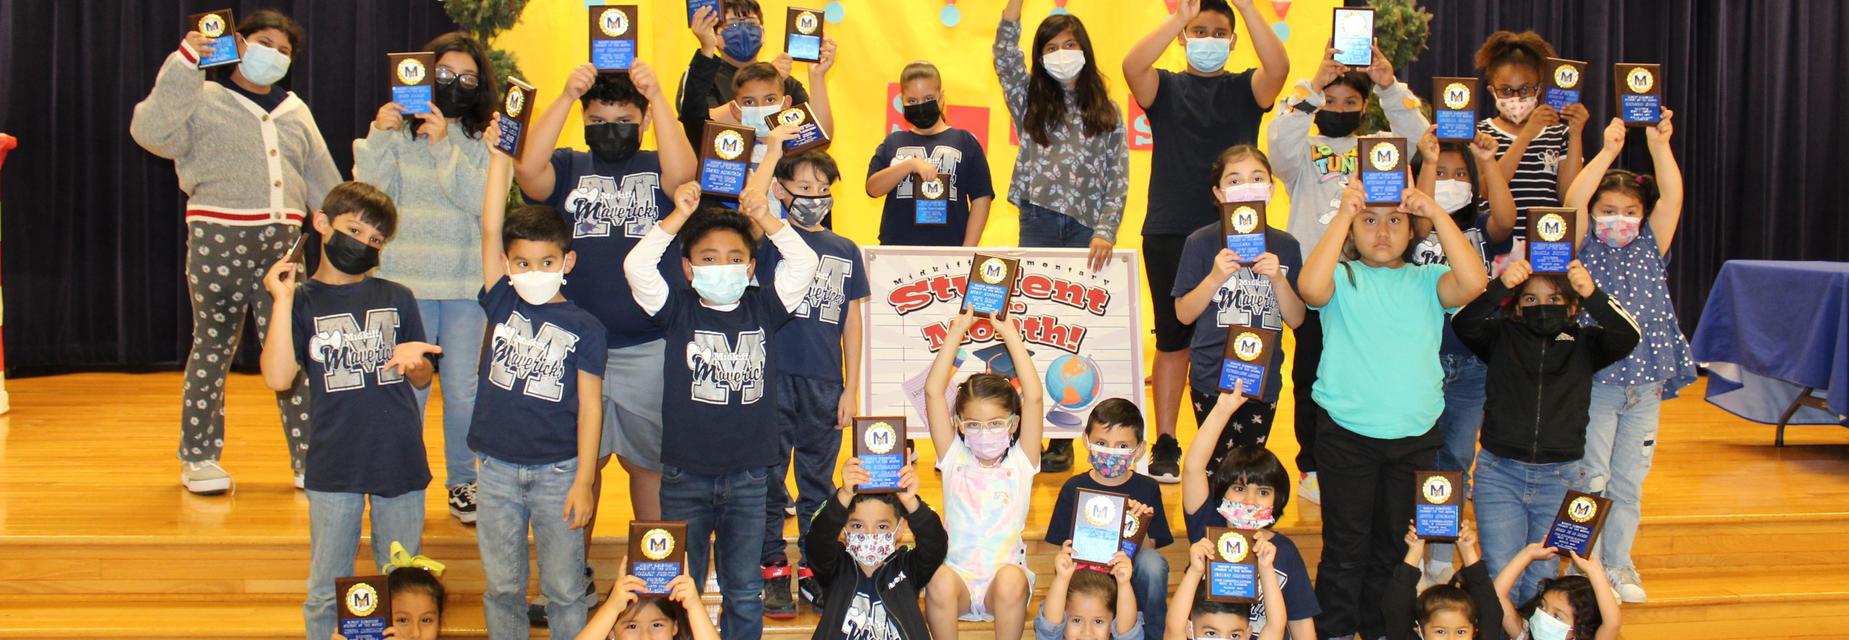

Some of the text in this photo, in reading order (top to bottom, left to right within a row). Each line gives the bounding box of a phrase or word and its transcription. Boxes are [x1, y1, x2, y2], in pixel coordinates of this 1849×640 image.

[206, 21, 218, 31] M
[607, 18, 620, 28] M
[801, 18, 812, 27] M
[405, 67, 418, 77] M
[1561, 72, 1572, 82] M
[1635, 76, 1646, 85] M
[1451, 91, 1463, 101] M
[785, 113, 799, 122] M
[723, 138, 736, 151] M
[1378, 151, 1390, 162] M
[1315, 156, 1356, 175] TUN
[928, 184, 938, 192] M
[573, 171, 660, 239] M
[574, 197, 659, 222] Mavericks
[1239, 214, 1251, 224] M
[1545, 222, 1559, 233] M
[987, 265, 1000, 276] M
[1026, 260, 1110, 285] mentary
[1218, 286, 1275, 310] Maveri
[314, 308, 404, 392] M
[1241, 340, 1256, 353] M
[320, 344, 395, 372] Maveric
[489, 310, 580, 402] M
[691, 326, 767, 405] M
[691, 354, 765, 385] Maveric
[873, 432, 888, 444] M
[1431, 485, 1444, 496] M
[1575, 503, 1589, 514] M
[651, 538, 666, 550] M
[1227, 541, 1240, 553] M
[354, 593, 369, 606] M
